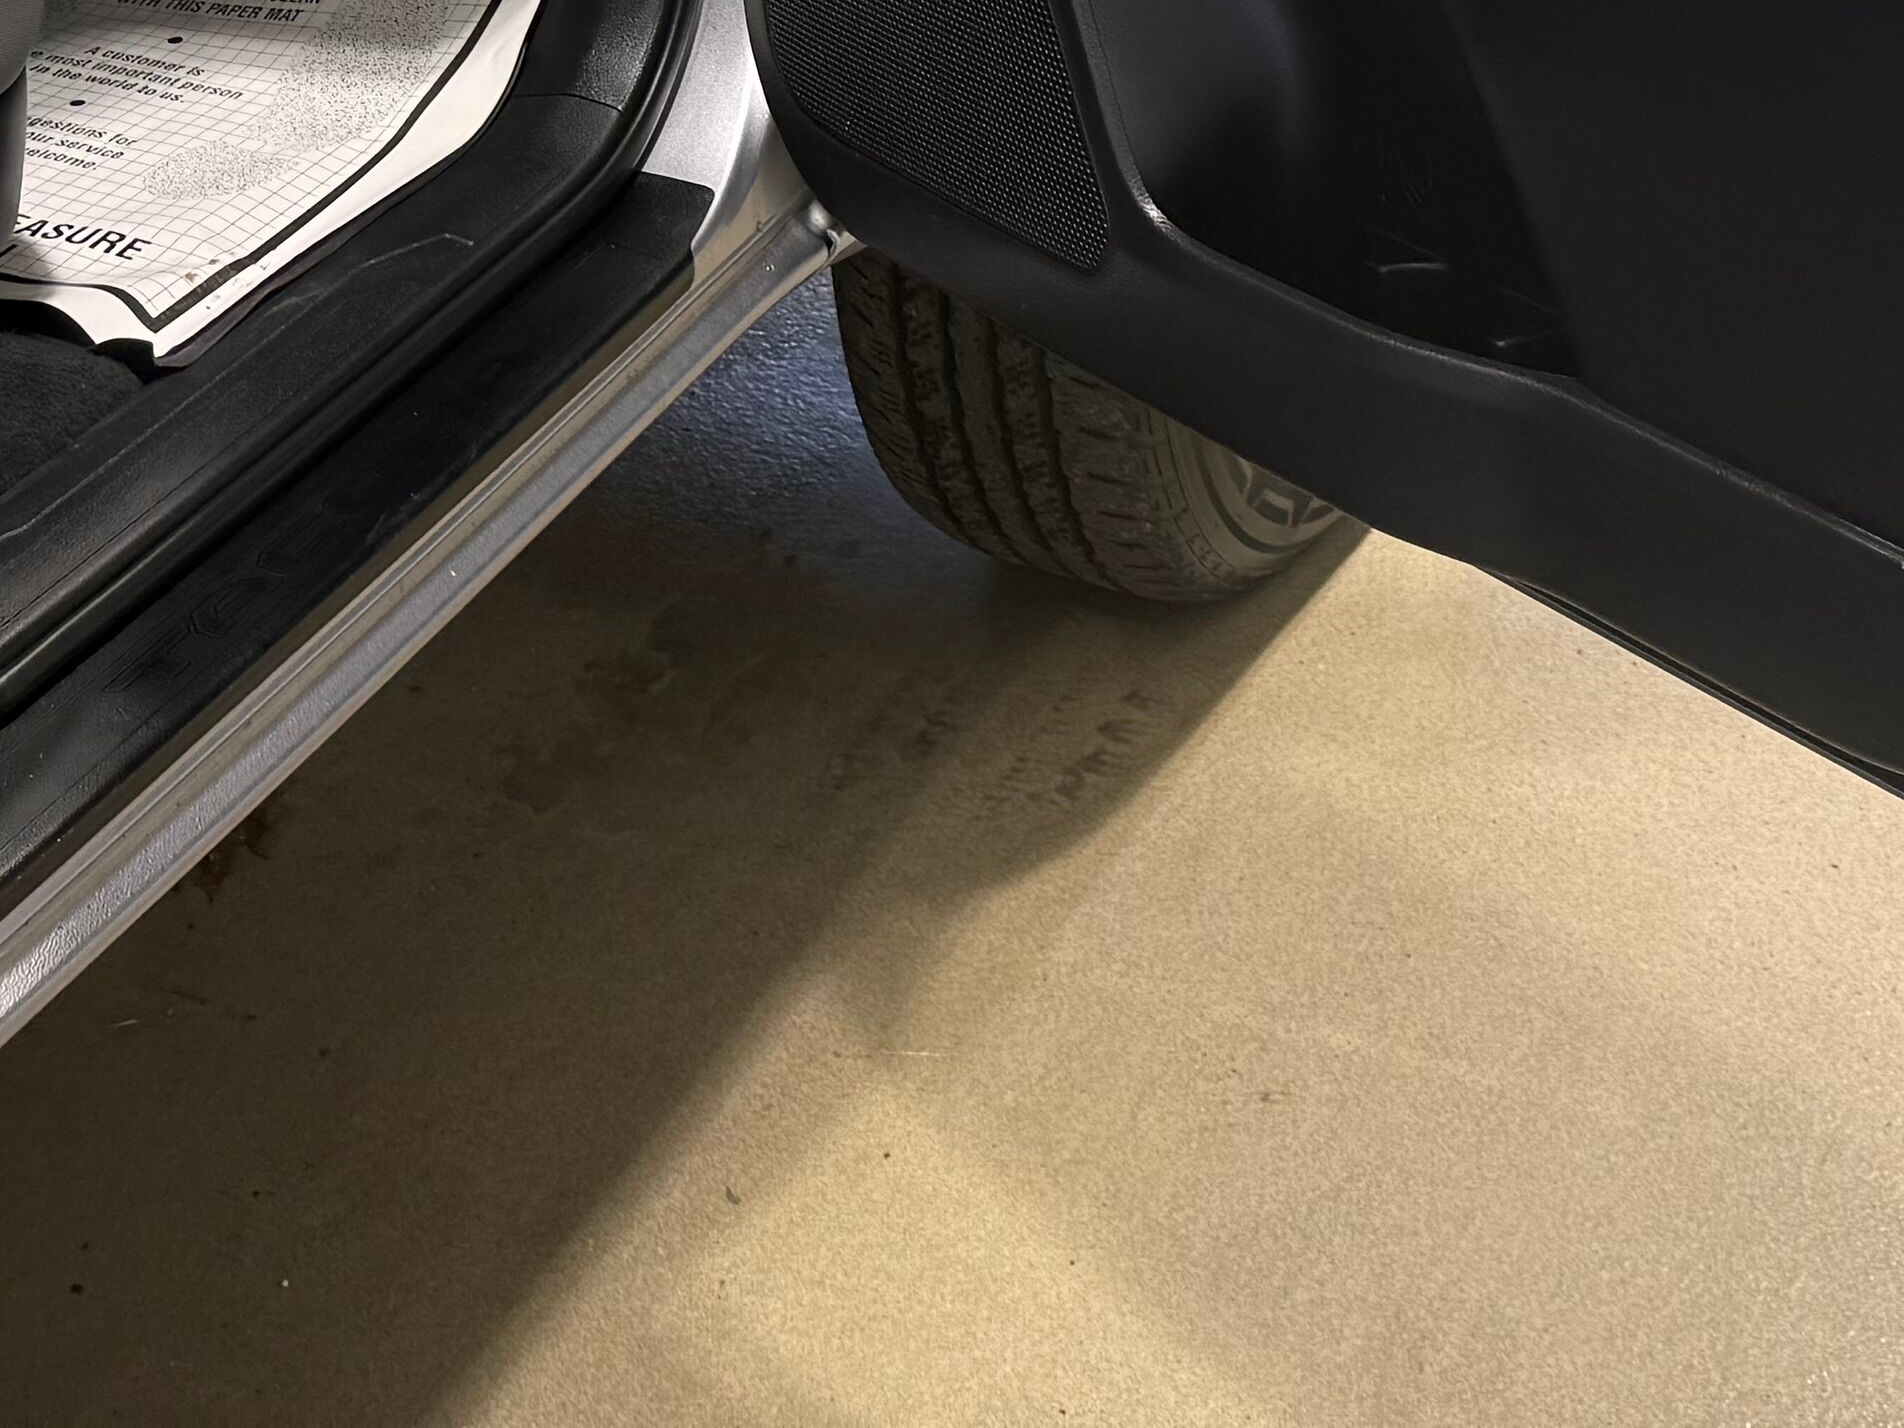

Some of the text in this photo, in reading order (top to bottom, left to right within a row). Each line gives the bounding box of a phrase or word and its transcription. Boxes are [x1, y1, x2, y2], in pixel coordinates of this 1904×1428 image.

[205, 2, 264, 20] PAPER
[264, 7, 304, 23] MAT
[45, 53, 93, 68] most
[91, 60, 181, 87] important
[177, 80, 244, 101] person
[84, 46, 205, 77] A customer is
[29, 63, 185, 104] in the world to us.
[26, 116, 139, 147] gestions for
[54, 139, 125, 159] service
